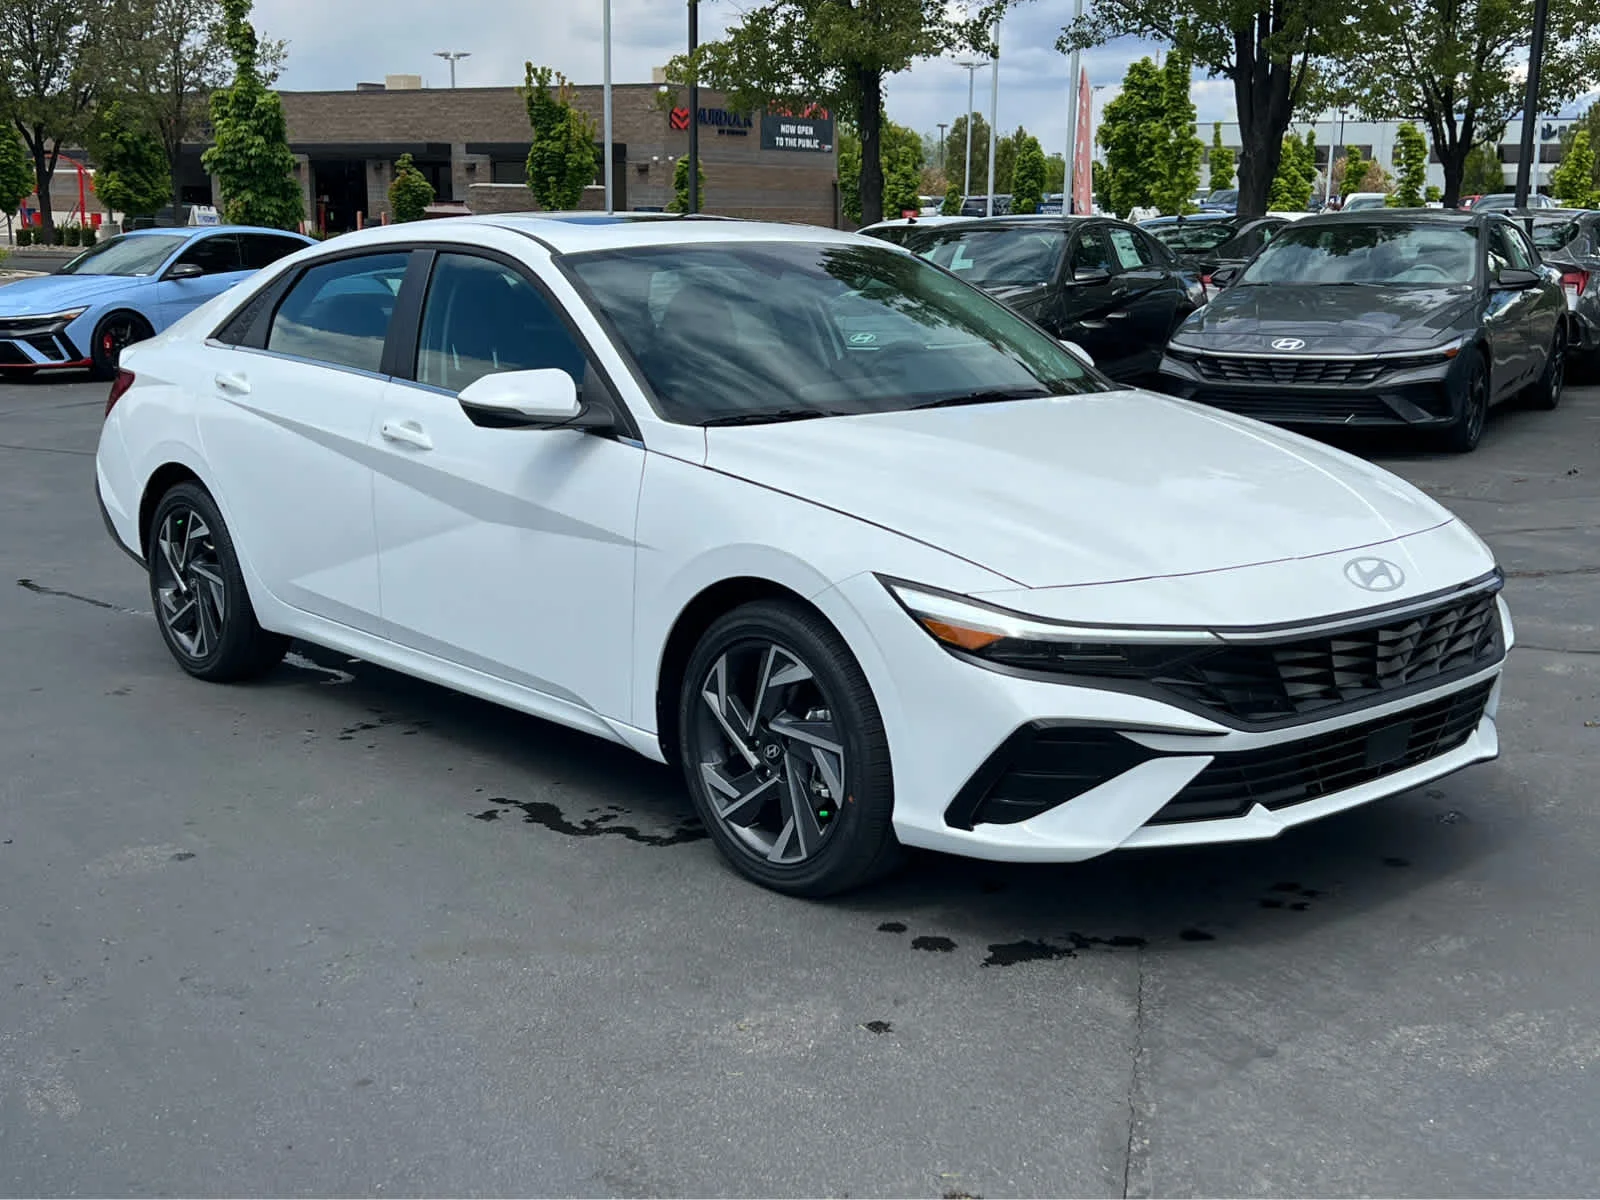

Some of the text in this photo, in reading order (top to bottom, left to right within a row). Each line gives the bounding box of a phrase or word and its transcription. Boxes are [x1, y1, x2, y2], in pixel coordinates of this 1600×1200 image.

[780, 124, 814, 136] NOW OPEN
[775, 136, 784, 147] TO
[785, 137, 797, 148] THE
[797, 138, 820, 149] PUBLIC
